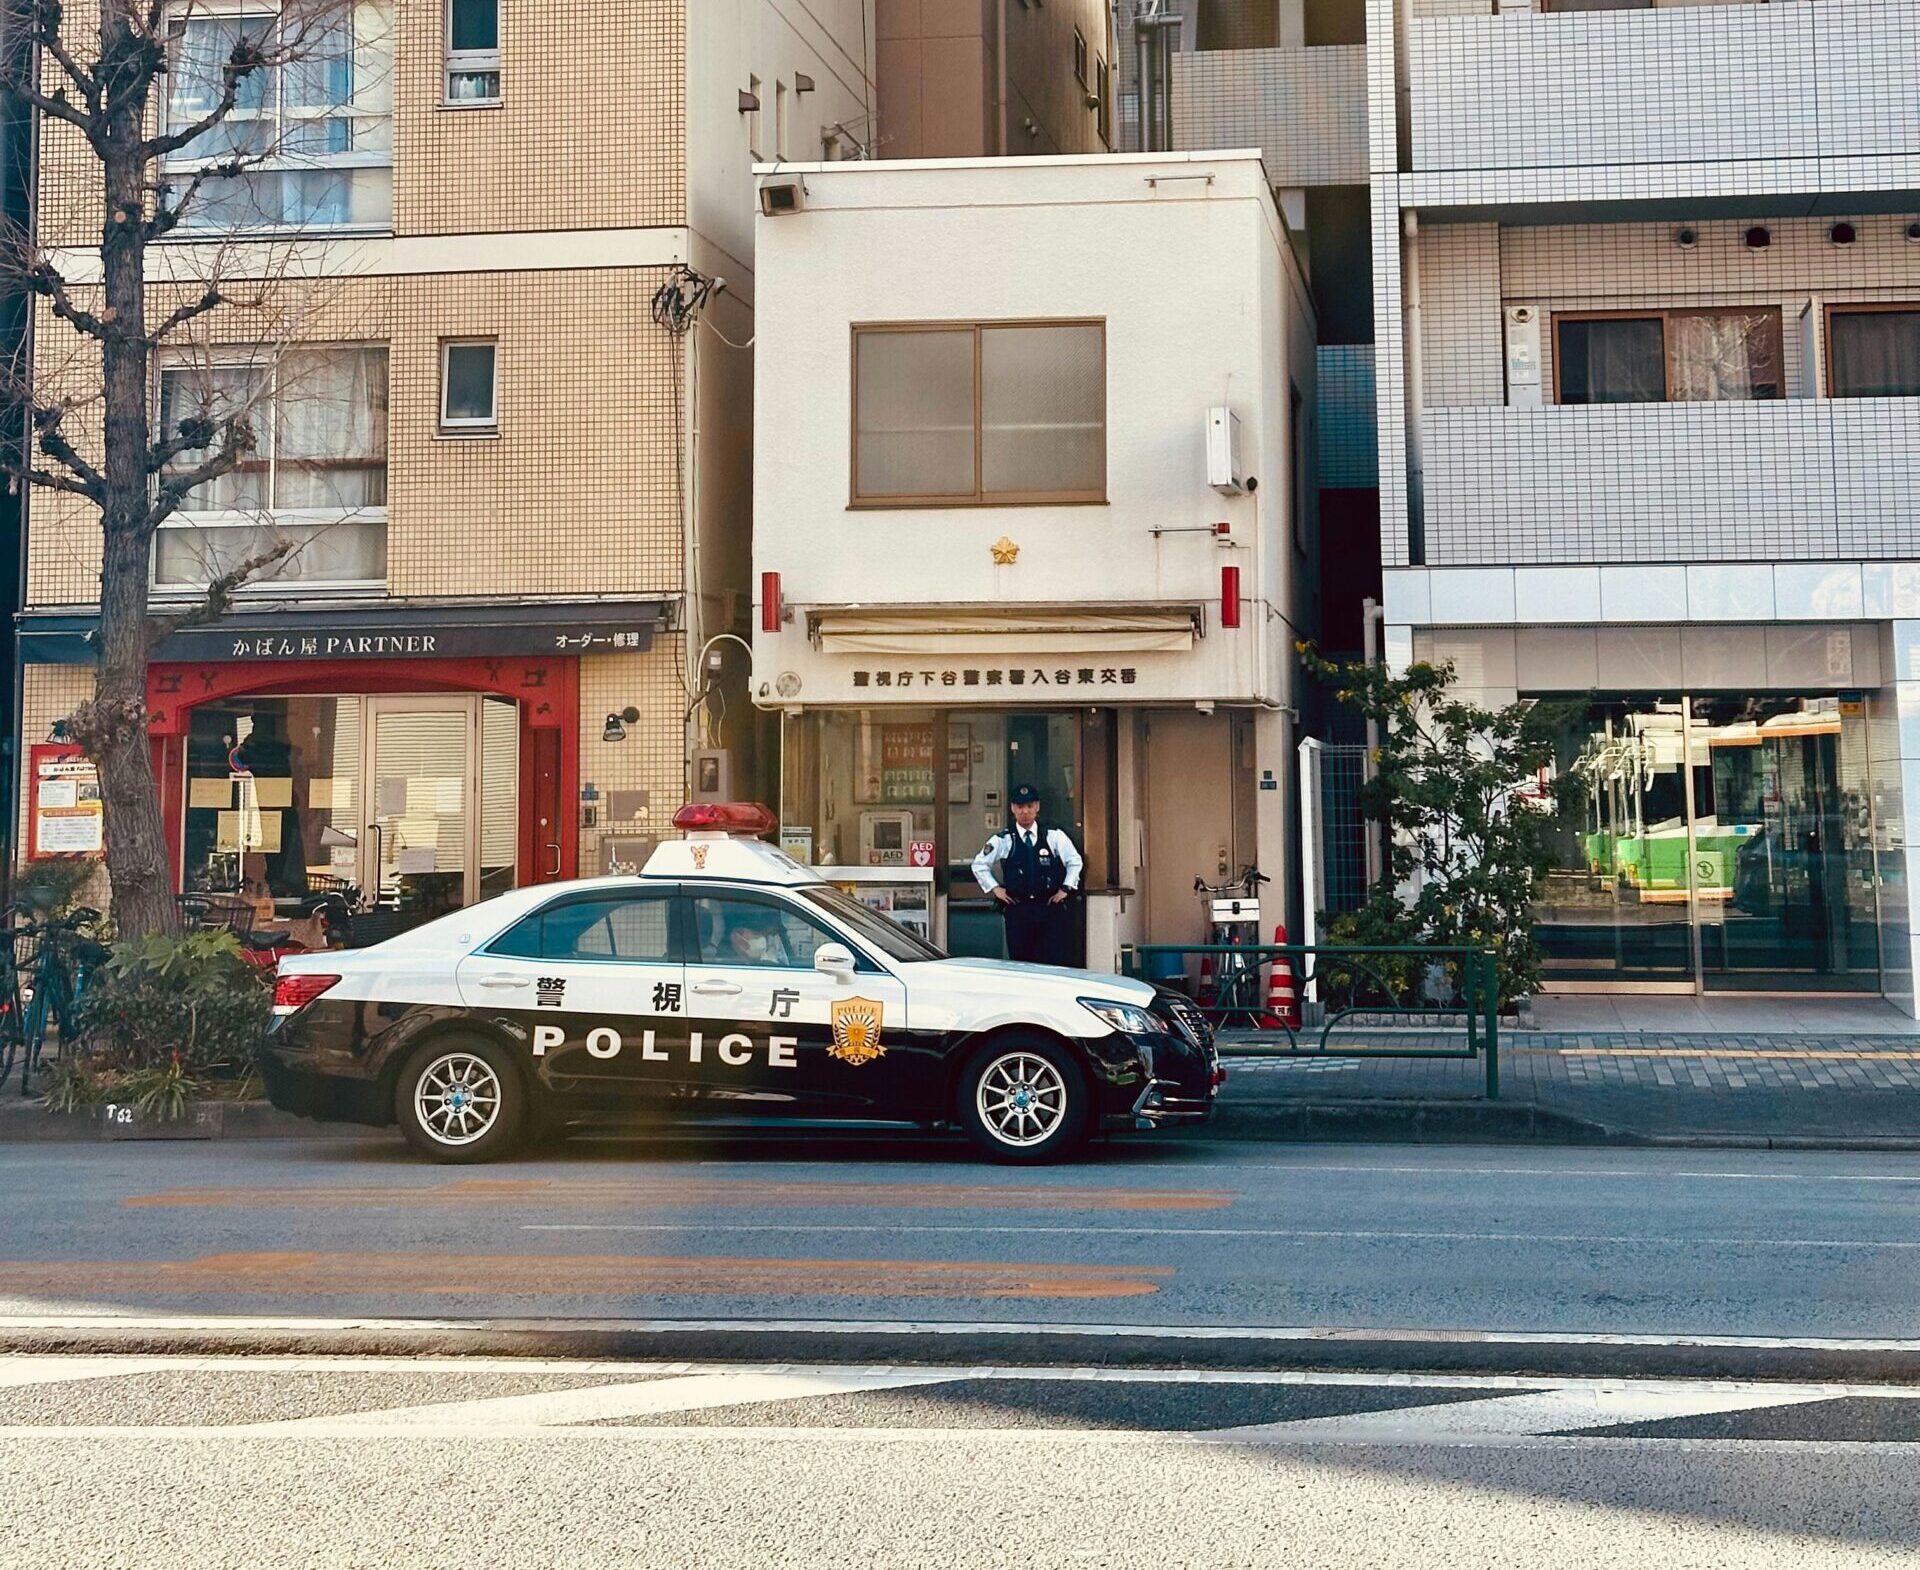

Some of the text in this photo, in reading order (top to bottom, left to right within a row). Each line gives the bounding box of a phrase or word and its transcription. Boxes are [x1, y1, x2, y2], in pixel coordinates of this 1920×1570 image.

[232, 635, 437, 656] かばん屋 PARTNER
[556, 632, 639, 648] オーダー・修理
[853, 668, 1137, 687] 警視庁下谷警察署入谷東交番
[882, 850, 904, 860] AED
[911, 842, 933, 851] AED
[536, 977, 800, 1018] 警視庁
[837, 1005, 878, 1016] POLICE
[532, 1025, 798, 1067] POLICE
